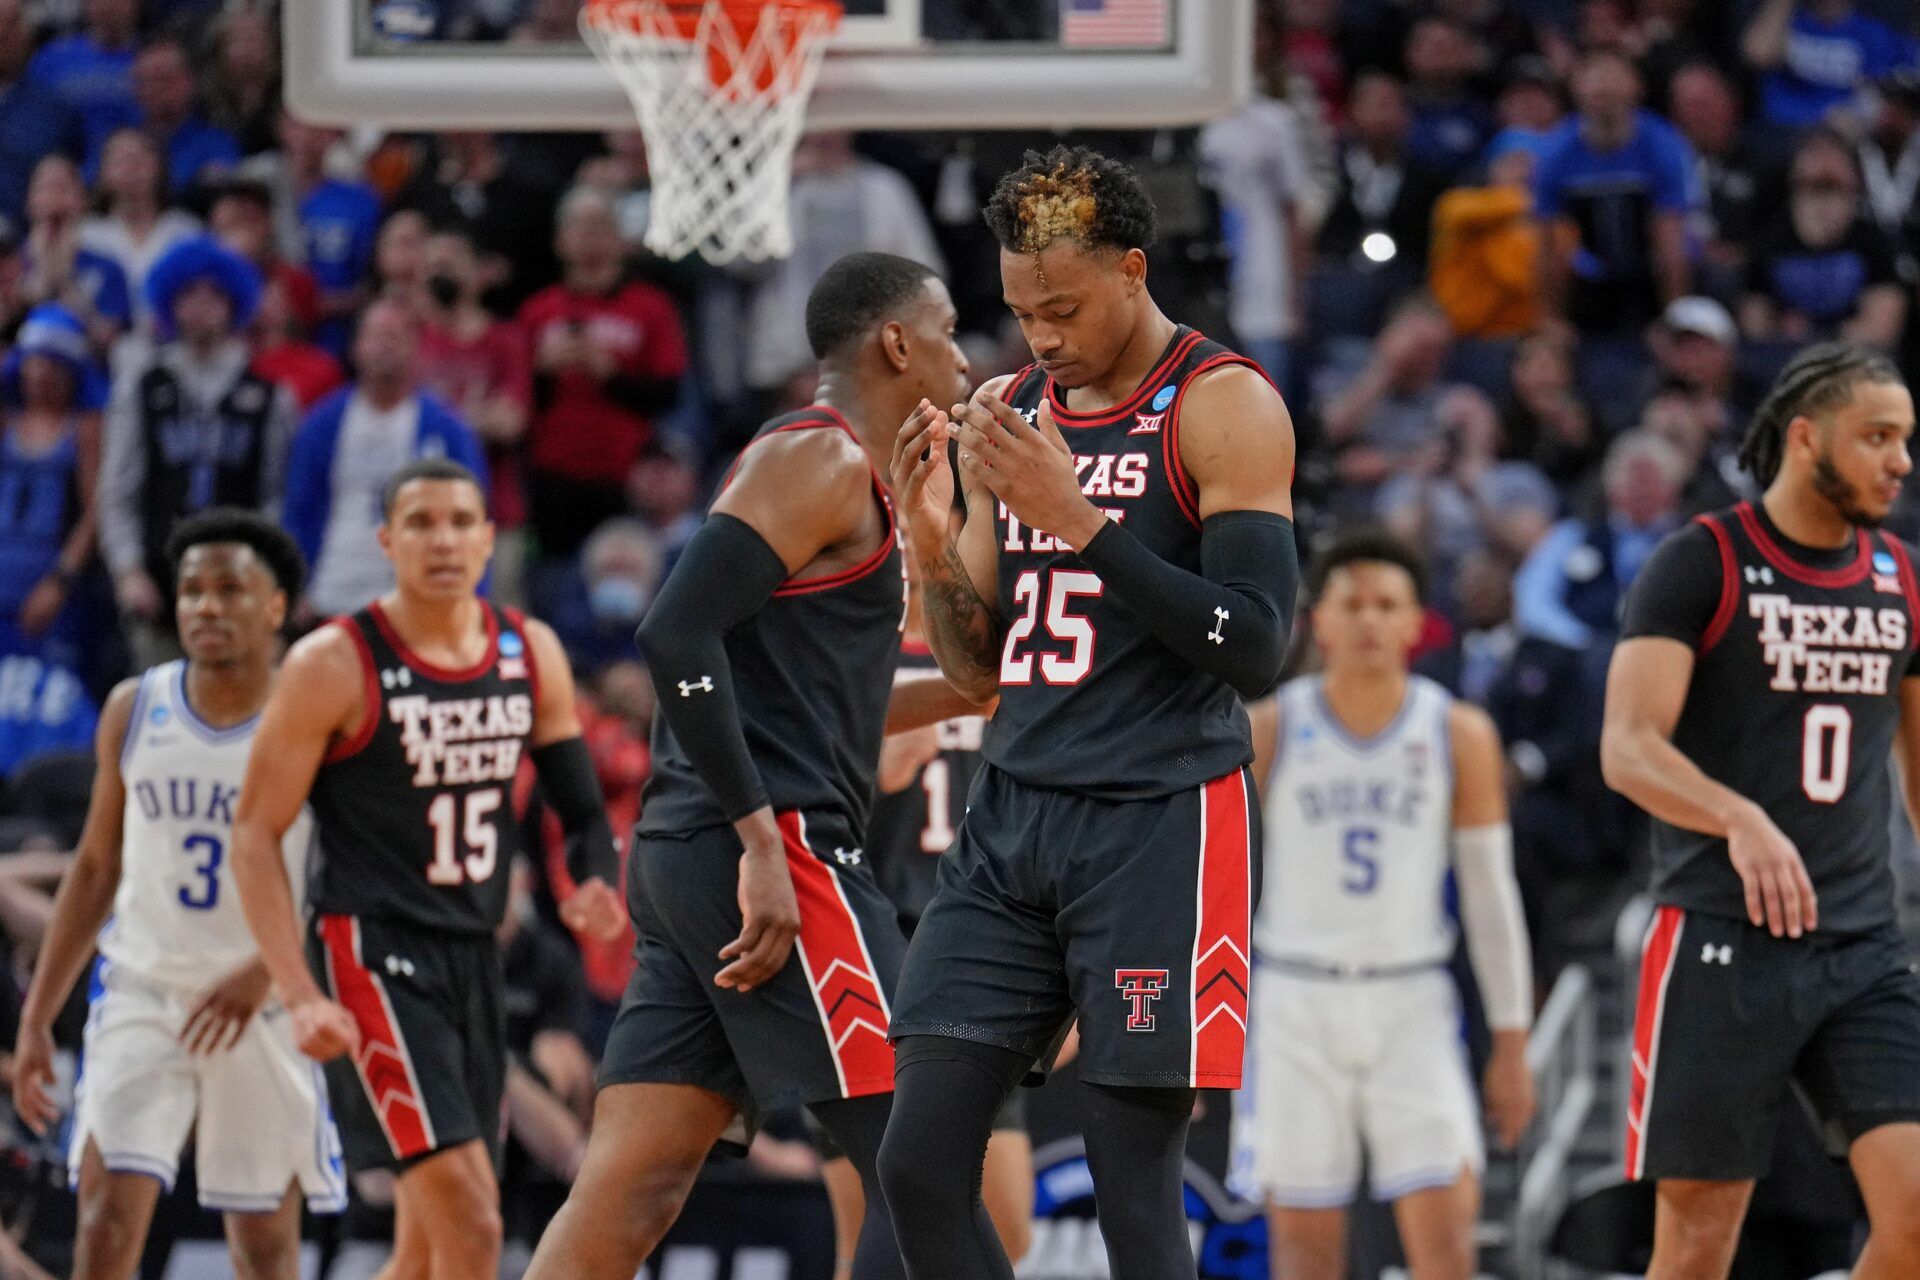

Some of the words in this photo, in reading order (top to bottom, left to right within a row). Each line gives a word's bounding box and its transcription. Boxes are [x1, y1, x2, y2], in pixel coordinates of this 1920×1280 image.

[999, 568, 1104, 687] 25
[1748, 593, 1907, 650] TEXAS
[1763, 642, 1892, 695] TECH
[388, 694, 532, 747] TEXAS
[406, 738, 523, 787] TECH
[1802, 703, 1852, 804] 0
[135, 777, 241, 826] DUK
[426, 788, 502, 885] 15
[1342, 826, 1380, 896] 5
[178, 833, 224, 911] 3
